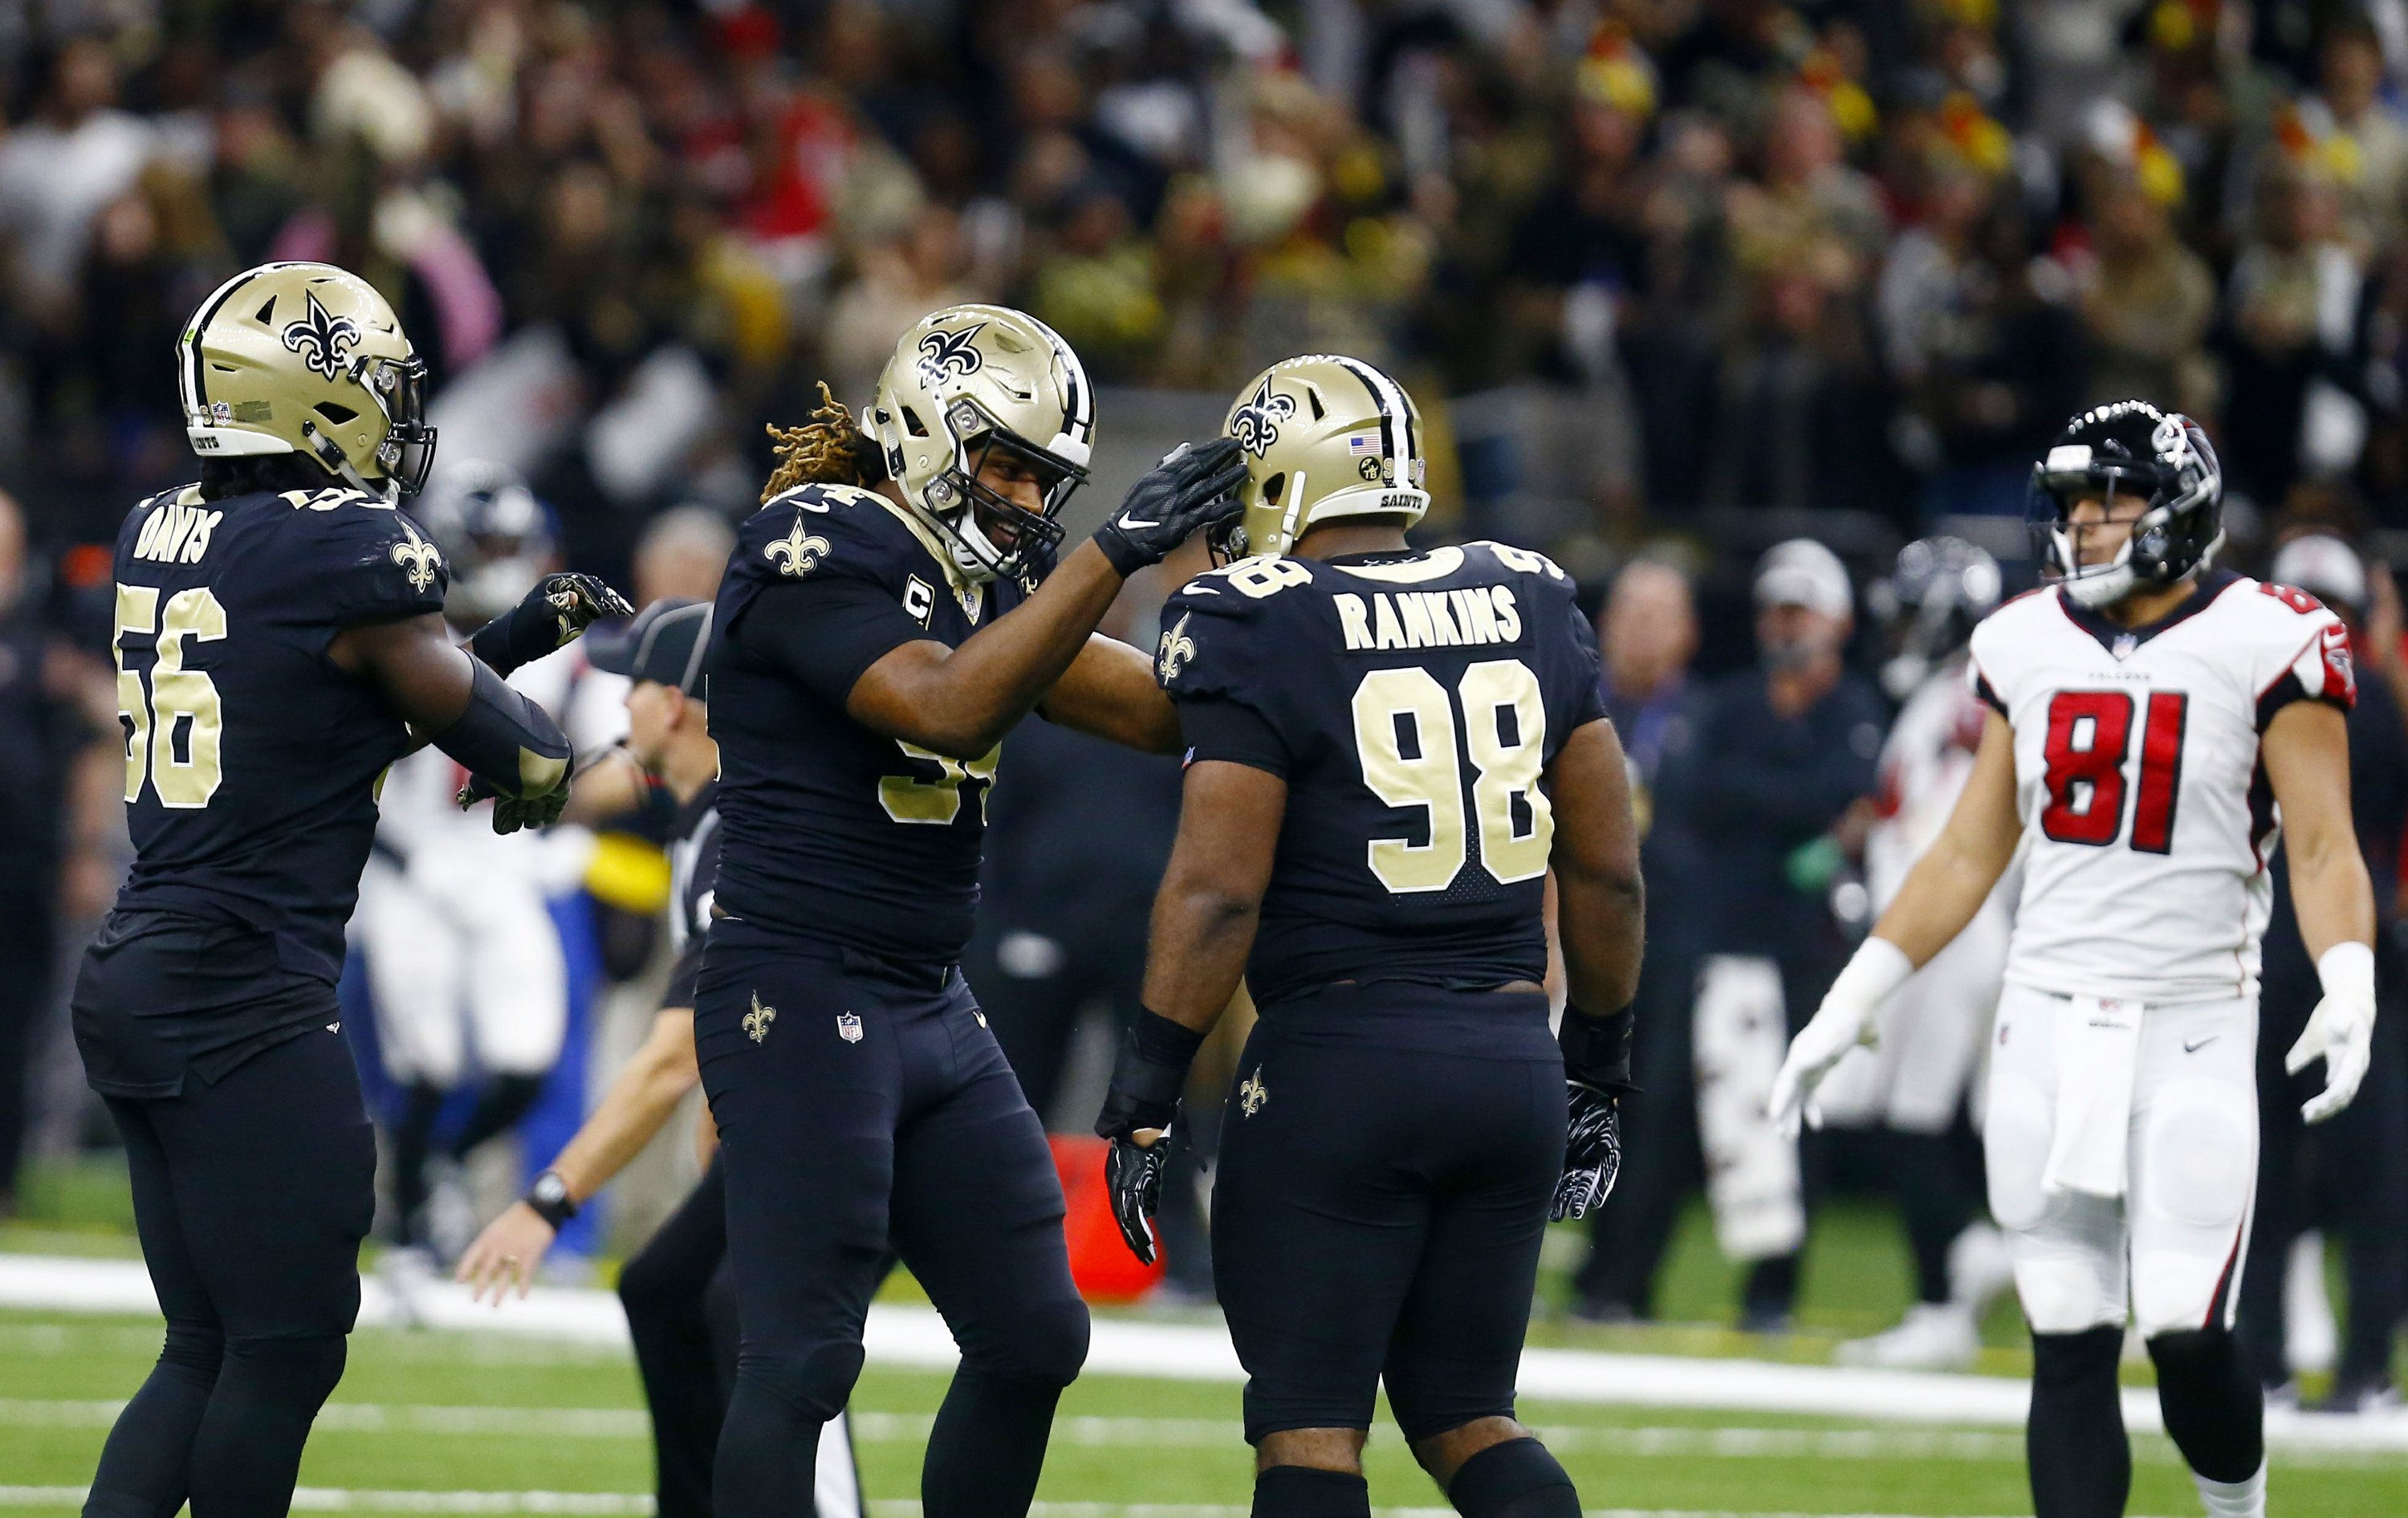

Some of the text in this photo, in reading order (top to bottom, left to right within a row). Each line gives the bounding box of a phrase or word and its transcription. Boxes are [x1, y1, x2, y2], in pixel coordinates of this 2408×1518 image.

[1364, 470, 1377, 479] TB
[1383, 458, 1394, 478] 9
[1381, 494, 1422, 509] SAINTS
[133, 504, 223, 564] DAVIS
[905, 580, 931, 619] C
[1333, 585, 1522, 651] RANKINS
[112, 582, 227, 808] 56
[1352, 658, 1555, 893] 98
[2041, 690, 2188, 855] 81
